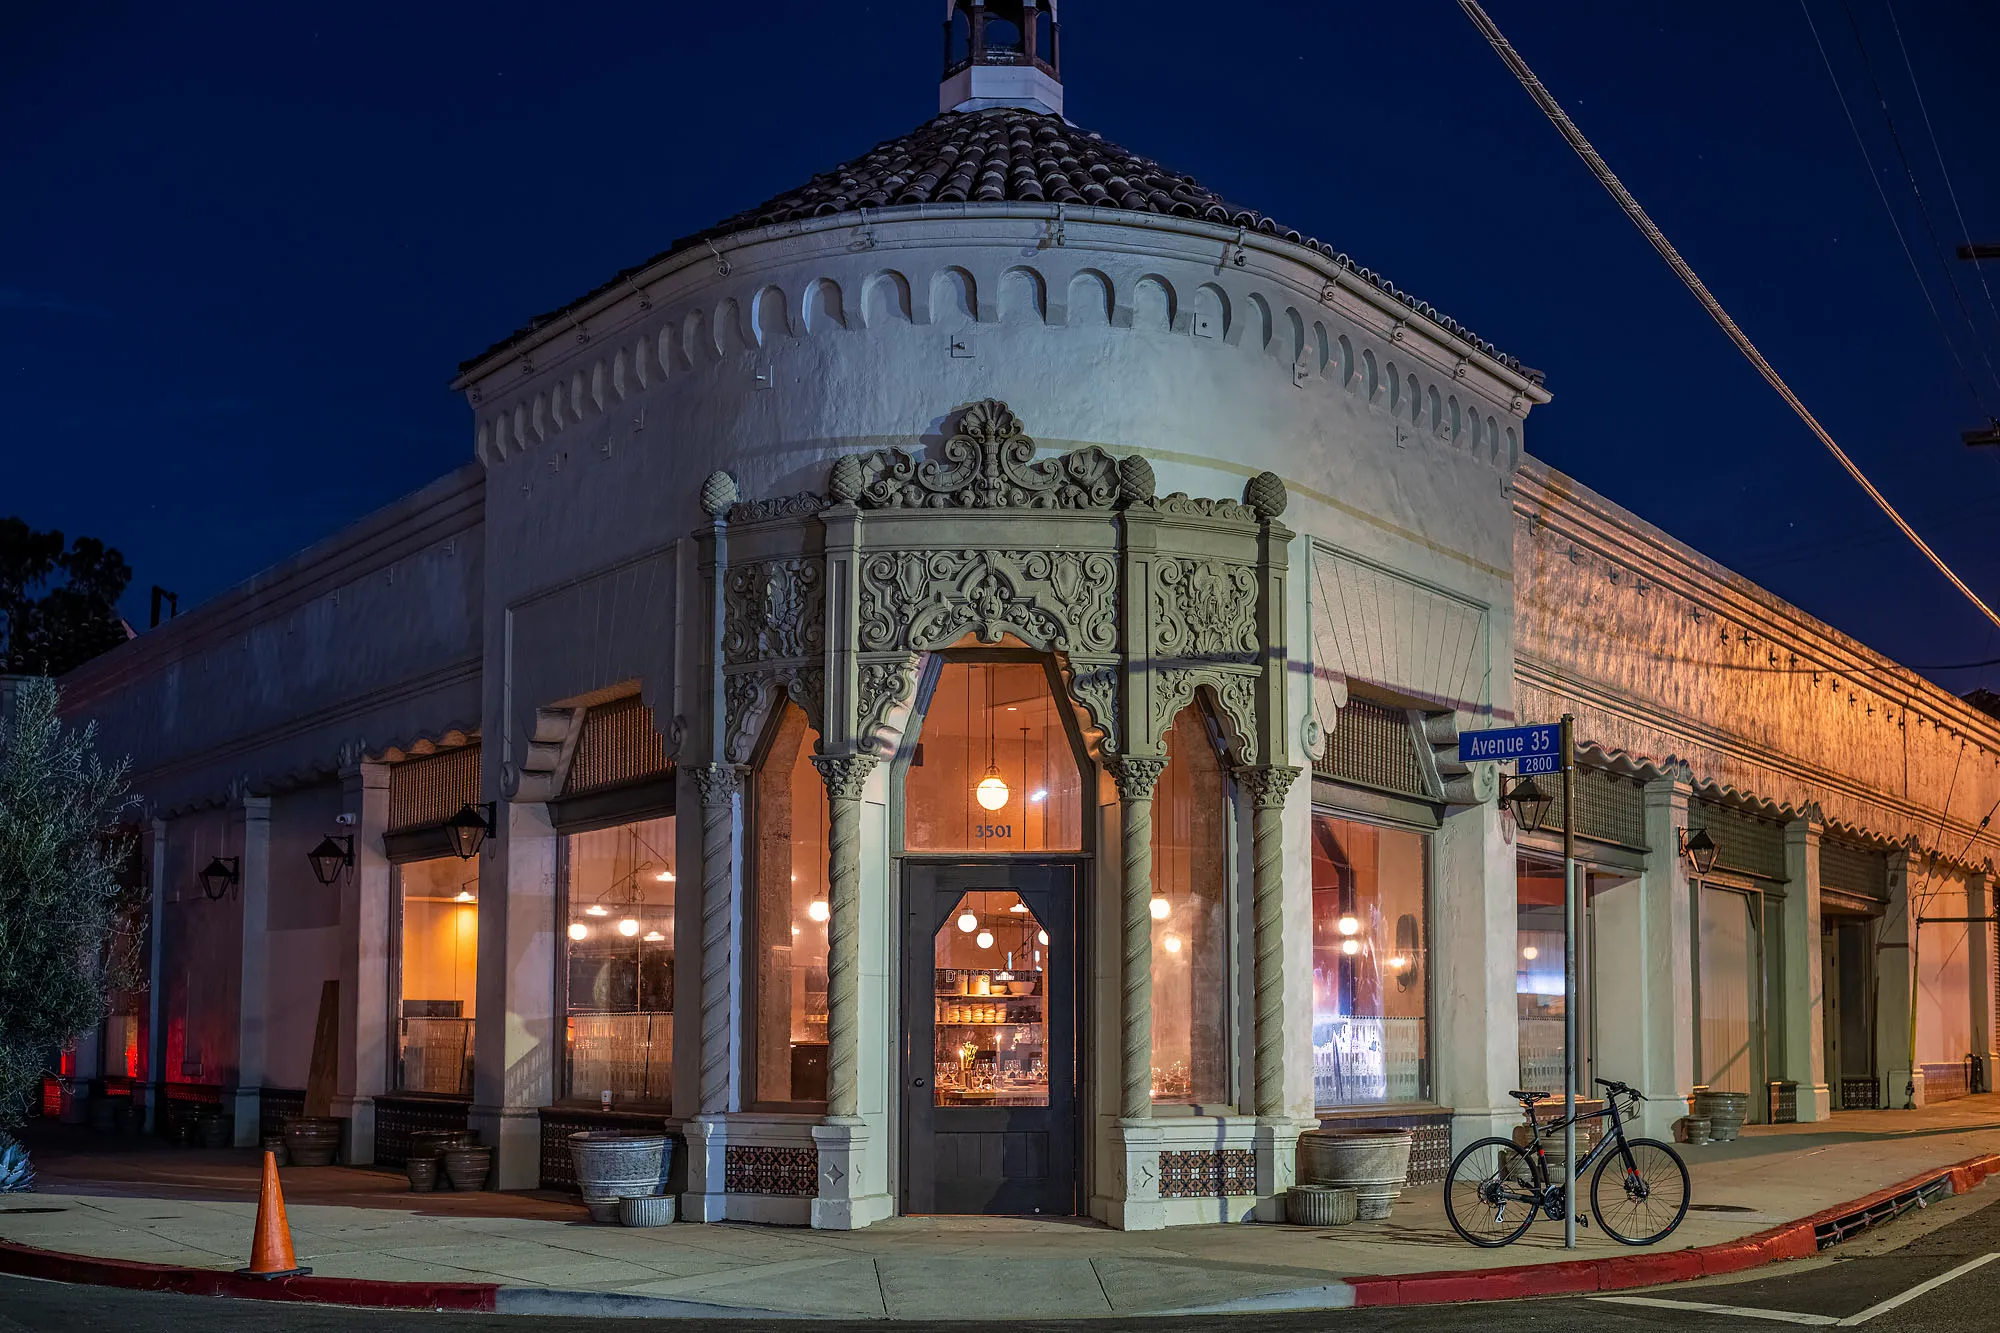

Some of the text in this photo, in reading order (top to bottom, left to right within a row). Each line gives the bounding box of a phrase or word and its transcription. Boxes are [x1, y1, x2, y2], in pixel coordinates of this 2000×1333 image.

[1471, 730, 1550, 756] Avenue 35
[1525, 756, 1552, 772] 2800
[975, 824, 1012, 838] 3501
